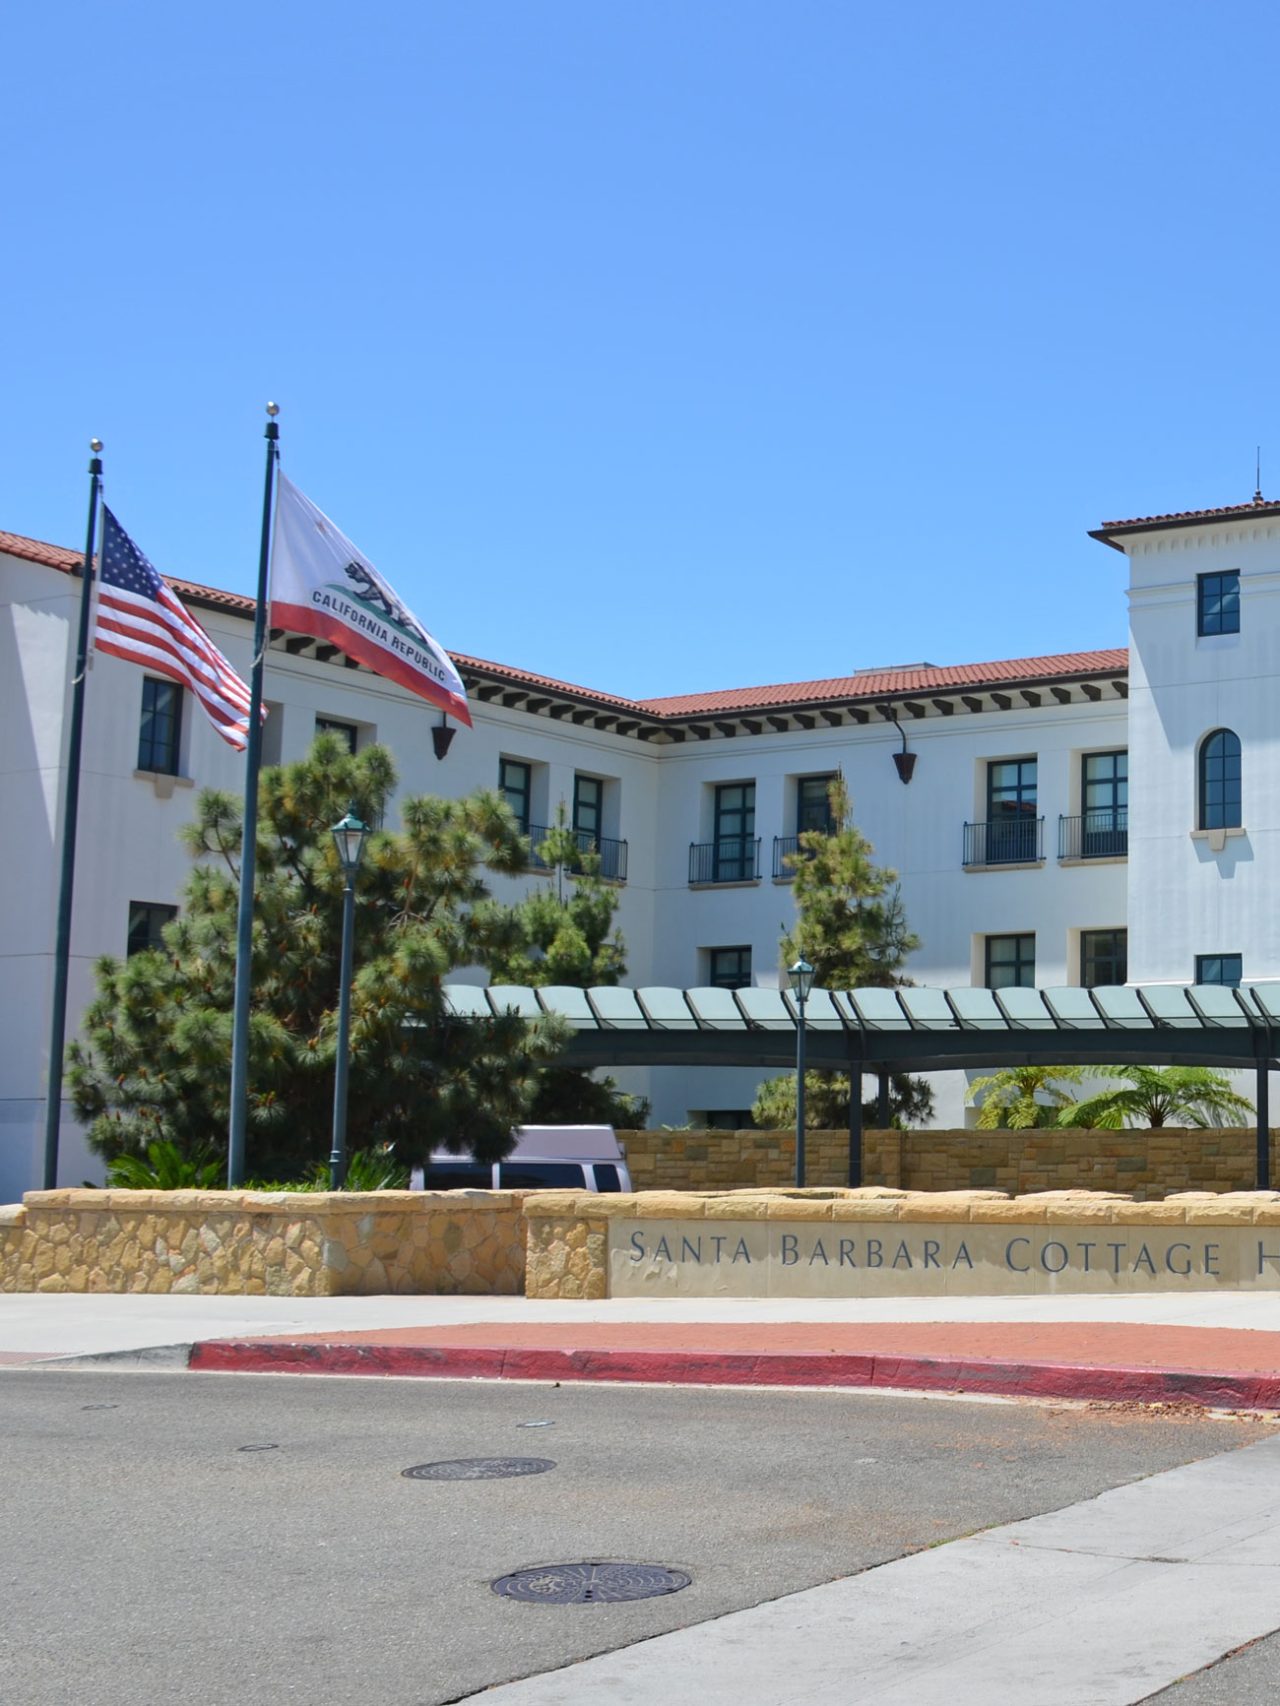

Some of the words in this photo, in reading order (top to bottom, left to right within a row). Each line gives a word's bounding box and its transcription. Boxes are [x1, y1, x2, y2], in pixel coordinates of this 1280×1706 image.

[312, 590, 388, 641] CALIFORNIA
[391, 634, 446, 682] REPUBLIC
[630, 1231, 752, 1264] SANTA
[781, 1234, 974, 1270] BARBARA
[1005, 1237, 1220, 1275] COTTAGE
